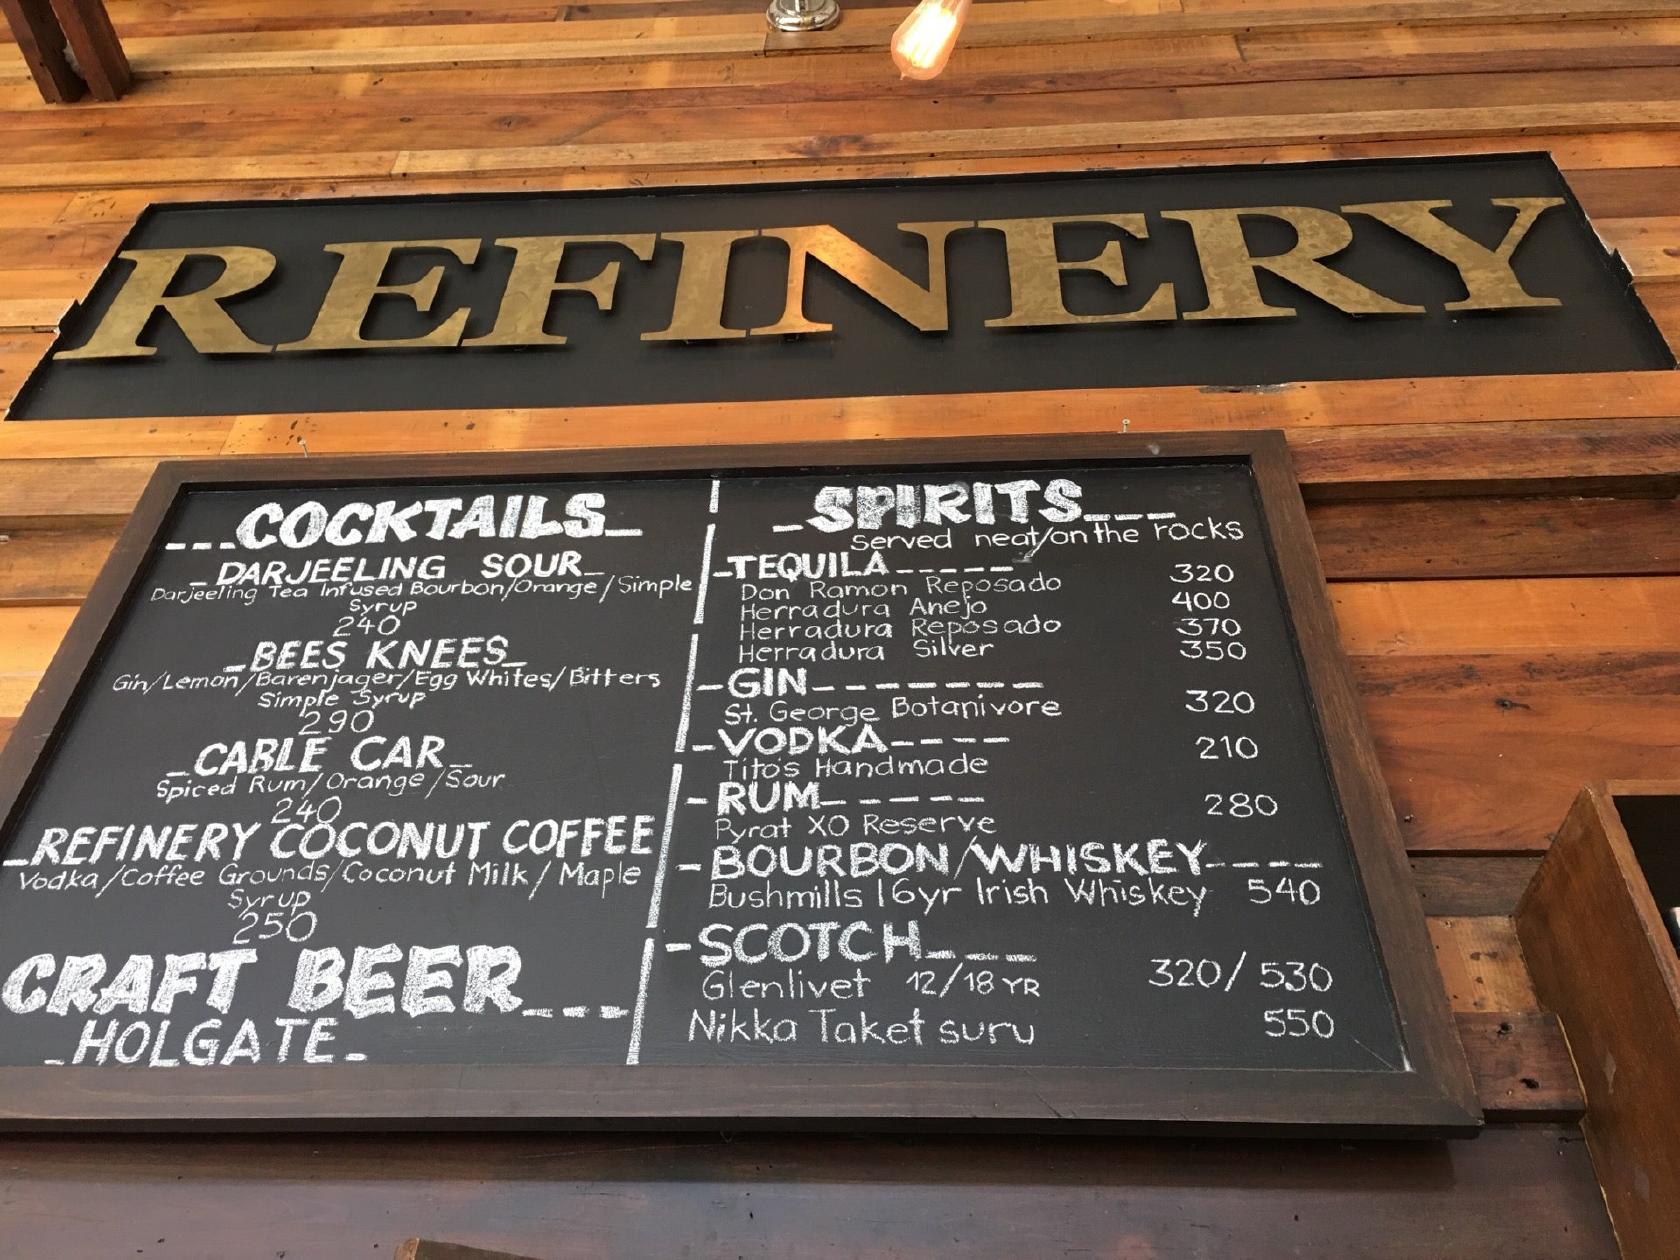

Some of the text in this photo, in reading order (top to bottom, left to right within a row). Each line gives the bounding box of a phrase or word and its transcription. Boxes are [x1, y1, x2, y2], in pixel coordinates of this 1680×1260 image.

[54, 196, 1564, 361] REFINERY
[236, 492, 606, 550] COCKTAILS
[806, 479, 1082, 533] SPIRITS
[850, 528, 952, 550] served
[1094, 522, 1140, 543] the
[1154, 516, 1244, 541] rocks
[215, 550, 583, 586] DARJEELING SOUR
[727, 550, 890, 583] TEQUILA
[1169, 563, 1235, 583] 320
[151, 583, 258, 606] Darjeeling
[271, 584, 308, 598] Tea
[320, 581, 403, 598] Infused
[742, 571, 1062, 601] Don Ramon Reposado
[1171, 591, 1231, 612] 400
[349, 598, 417, 616] Syrup
[740, 600, 890, 622] Herradura
[332, 614, 401, 637] 240
[739, 614, 1062, 645] Herradura Reposado
[1176, 617, 1242, 637] 370
[250, 635, 509, 671] BEES KNEES
[738, 636, 995, 664] Herradura Silver
[1179, 640, 1247, 661] 350
[727, 667, 807, 698] GIN
[257, 689, 427, 717] Simple Syrup
[724, 694, 1063, 727] St. George Botanivore
[1184, 690, 1255, 714] 320
[298, 709, 375, 735] 290
[717, 723, 889, 756] VODKA
[1199, 735, 1259, 760] 210
[193, 735, 446, 776] CABLE CAR
[722, 753, 989, 781] Tito's Handmade
[156, 776, 238, 804] Spiced
[717, 780, 821, 816] RUM
[1204, 794, 1278, 817] 280
[270, 796, 342, 824] 240
[29, 815, 656, 866] REFINERY COCONUT COFFEE
[715, 816, 793, 844] Pyrat
[863, 813, 998, 835] Reserve
[227, 888, 312, 918] Syrup
[708, 876, 1208, 918] Bushmills 16yr Irish Whiskey
[1247, 877, 1321, 905] 540
[232, 911, 318, 945] 250
[698, 919, 922, 968] SCOTCH
[1, 944, 525, 1016] CRAFT BEER
[702, 968, 872, 1000] Glenlivet
[1001, 976, 1041, 998] YR
[688, 1007, 798, 1043] Nikka
[1264, 1009, 1336, 1040] 550
[72, 1017, 338, 1068] HOLGATE
